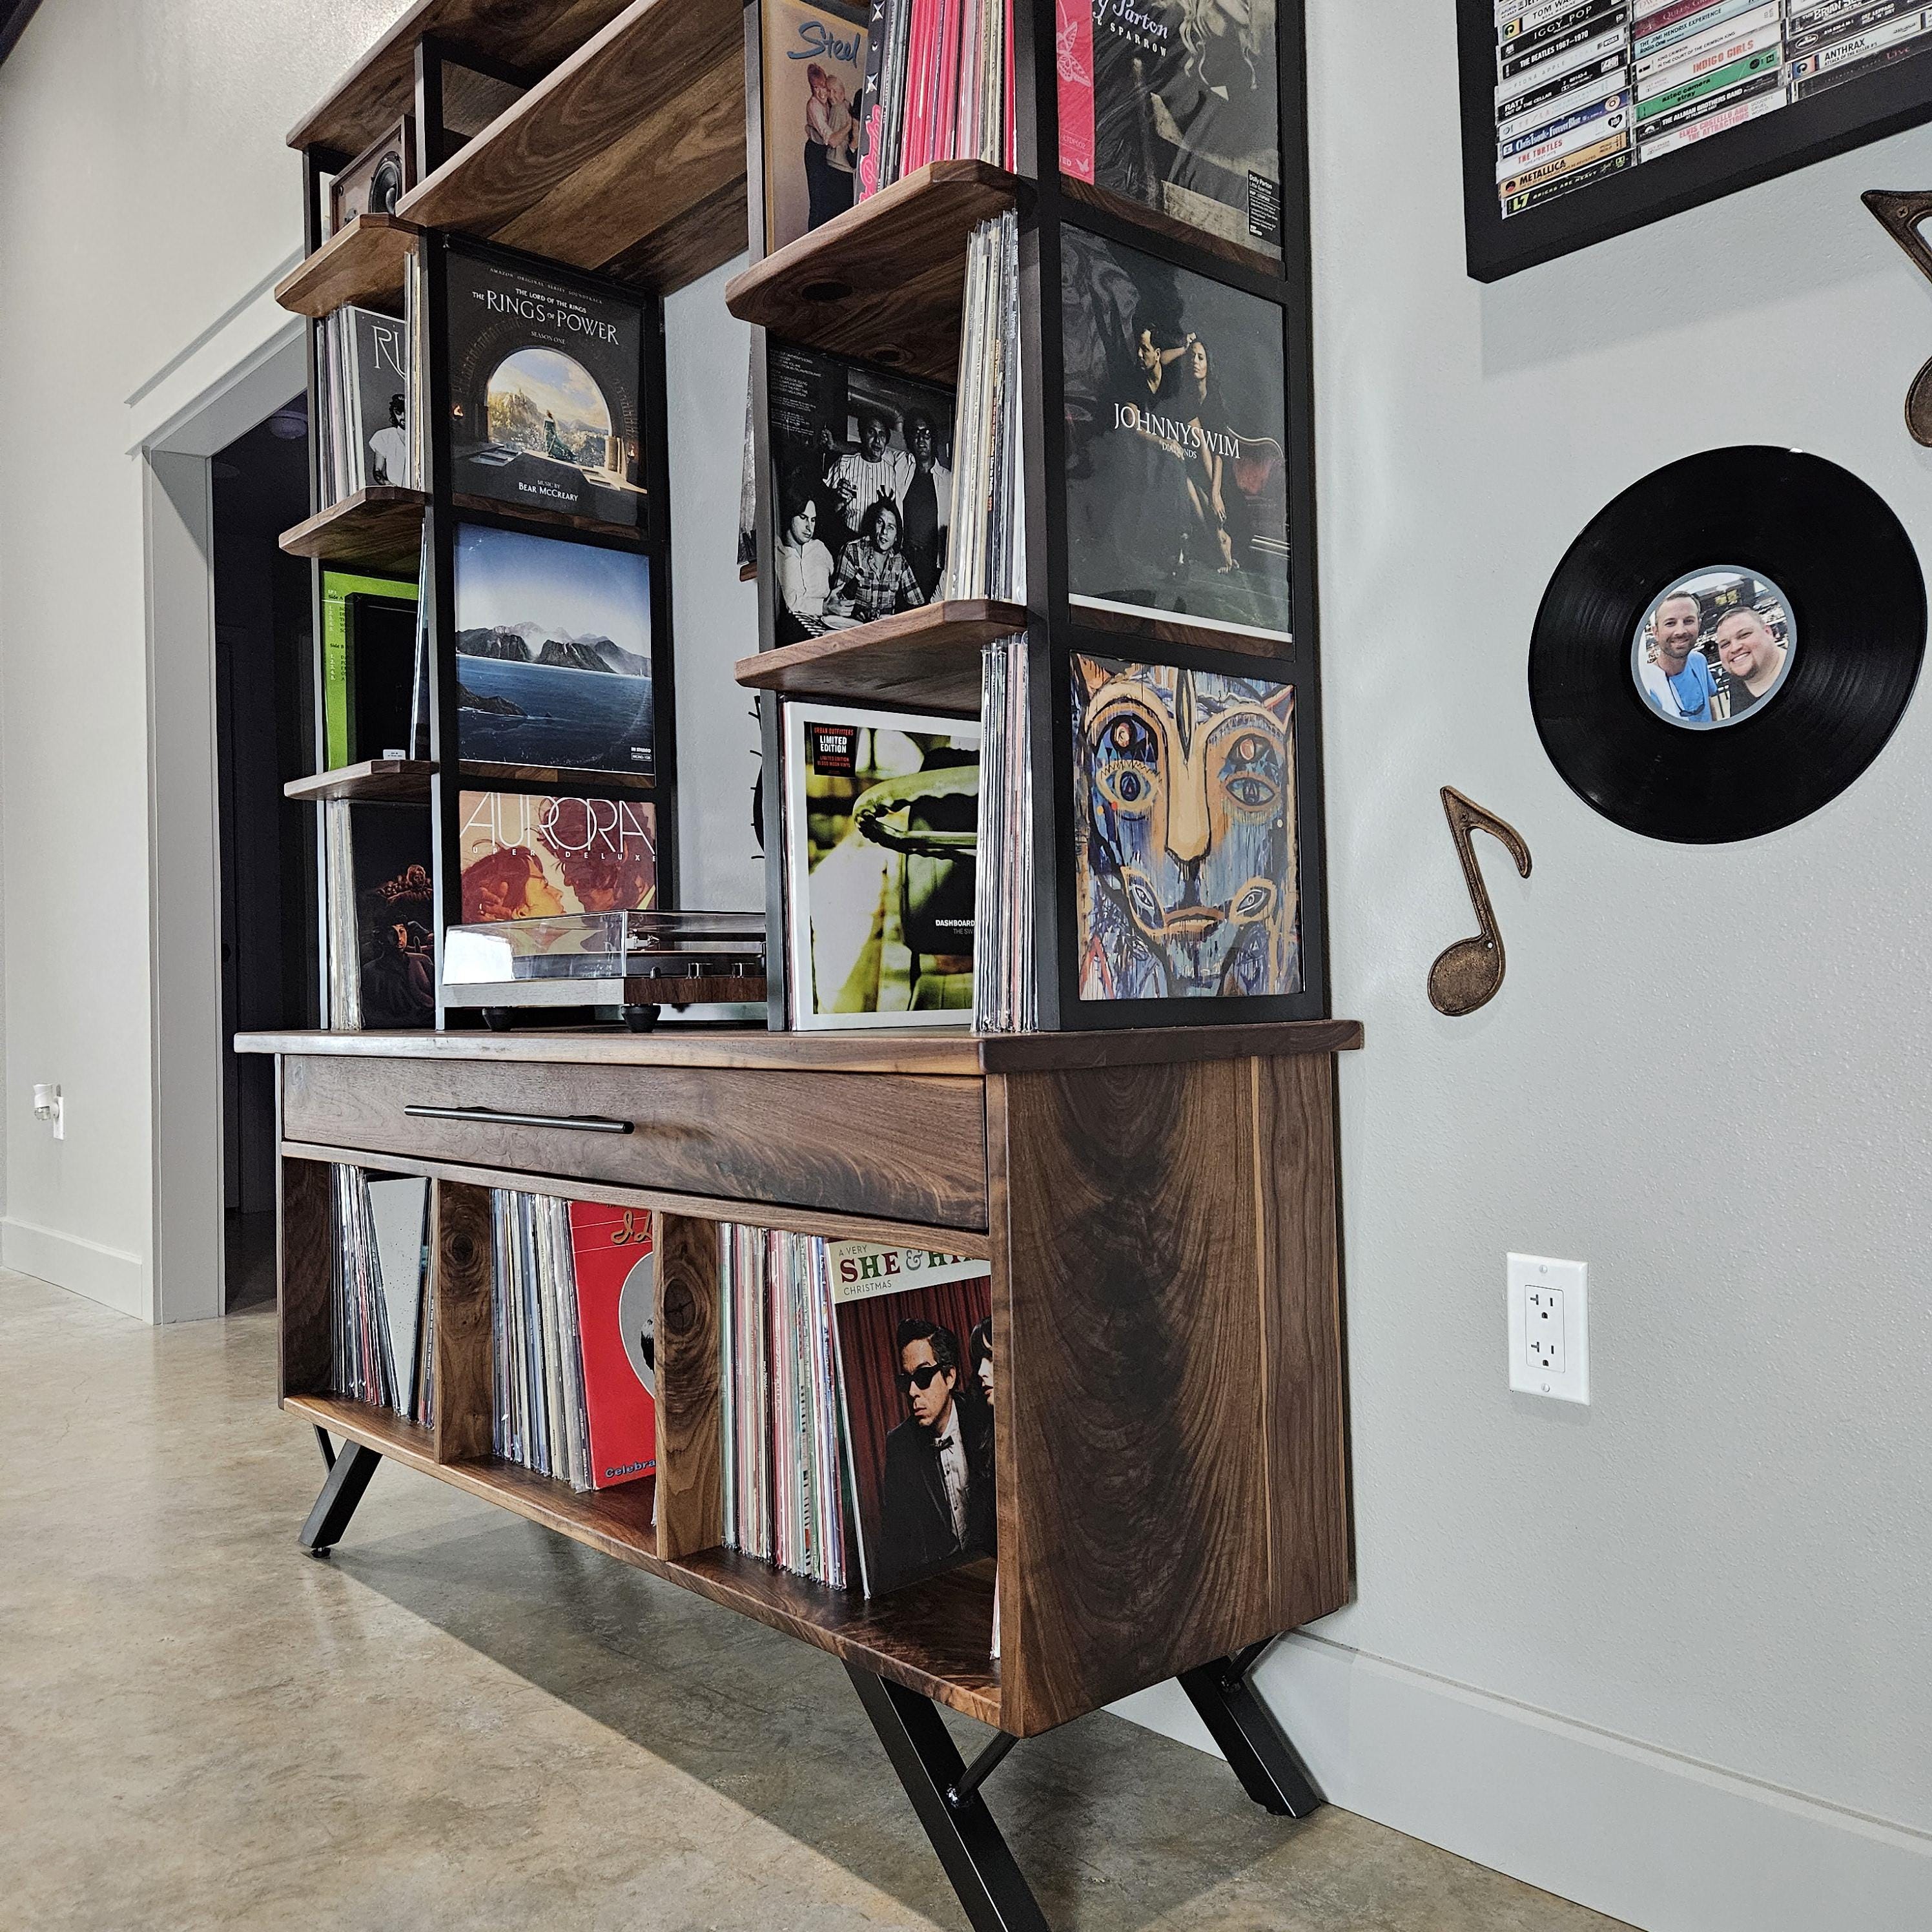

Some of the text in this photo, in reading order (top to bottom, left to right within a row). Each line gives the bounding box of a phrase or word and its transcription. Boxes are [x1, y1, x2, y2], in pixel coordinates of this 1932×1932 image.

[1112, 0, 1168, 39] Parton
[1532, 5, 1552, 19] TOM
[1813, 1, 1842, 21] BRIAN
[1534, 6, 1592, 39] IGGY POP
[1640, 39, 1649, 48] THE
[1650, 34, 1663, 45] JIMI
[1663, 25, 1688, 38] HENDRIX
[1688, 8, 1722, 27] EXPERIENCE
[786, 20, 861, 69] Steel
[1110, 22, 1167, 57] SPARROW
[1640, 39, 1667, 54] Radio One
[1663, 58, 1672, 67] THE
[1672, 52, 1689, 63] COURT
[1694, 45, 1703, 53] THE
[1703, 36, 1724, 48] CRIMSON
[1725, 31, 1736, 40] KING
[1824, 37, 1865, 61] ANTHRAX
[1519, 56, 1530, 68] THE
[1531, 46, 1555, 62] BEATLES
[1657, 45, 1689, 63] KING CRIMSON
[1692, 39, 1755, 74] INDIGO GIRLS
[1824, 56, 1840, 67] ATTACK
[1856, 45, 1870, 54] KILLER
[1514, 61, 1565, 88] FIONA APPLE
[1504, 97, 1525, 112] RATT
[1533, 92, 1552, 103] CELLAR
[1662, 88, 1743, 127] THE ALLMAN BROTHERS BAND
[1679, 103, 1749, 139] ELVIS COSTELLO AND
[1751, 106, 1769, 116] WORLD
[1689, 112, 1750, 142] THE ATTRACTIONS
[1518, 139, 1563, 164] THE TURTLES
[1519, 159, 1567, 186] METALLICA
[1559, 180, 1574, 189] ARE
[1513, 193, 1530, 212] L7
[490, 267, 513, 278] AMAZON
[517, 275, 545, 287] ORIGINAL
[515, 287, 528, 297] THE
[529, 292, 546, 302] LORD
[555, 299, 568, 309] THE
[569, 303, 588, 314] RINGS
[472, 289, 620, 346] THE RINGS OF POWER
[531, 330, 566, 345] SEASON ONE
[1114, 402, 1240, 459] JOHNNYSWIM
[519, 481, 537, 494] BEAR
[819, 735, 847, 745] LIMITED
[820, 743, 847, 754] EDITION
[459, 790, 655, 856] AURORA
[472, 847, 656, 863] UPER DELUXE
[935, 919, 976, 927] DASHBOARD
[846, 1244, 868, 1256] VERY
[839, 1251, 901, 1284] SHE
[906, 1248, 923, 1271] &
[843, 1279, 892, 1296] CHRISTMAS
[605, 1459, 656, 1479] Celebra
